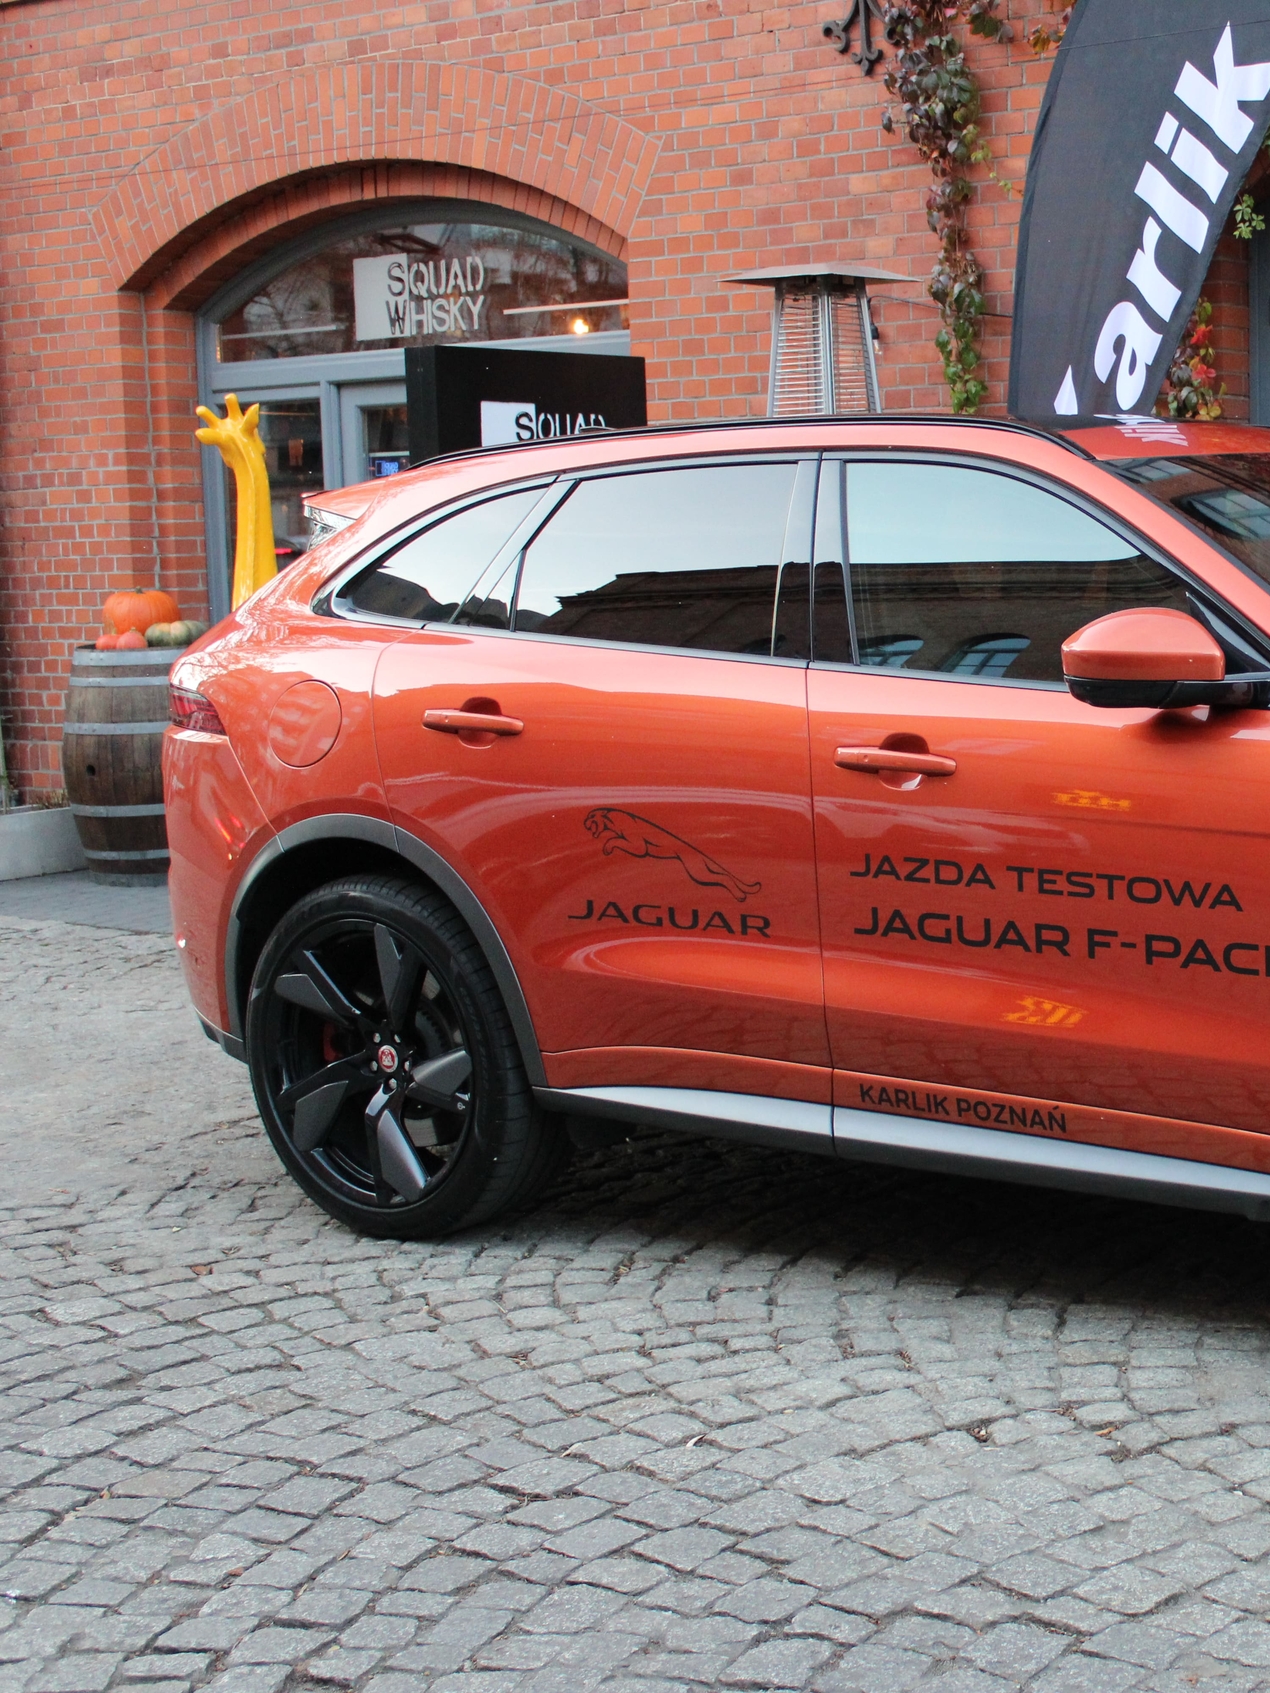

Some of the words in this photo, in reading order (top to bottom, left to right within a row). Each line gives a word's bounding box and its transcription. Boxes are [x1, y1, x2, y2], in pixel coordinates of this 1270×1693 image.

[387, 256, 484, 296] SQUAD
[386, 295, 484, 336] WHISKY
[850, 853, 996, 890] JAZDA
[1006, 865, 1244, 912] TESTOWA
[567, 899, 772, 938] JAGUAR
[853, 907, 1071, 957] JAGUAR
[859, 1083, 949, 1116] KARLIK
[955, 1098, 1067, 1134] POZNAŃ
